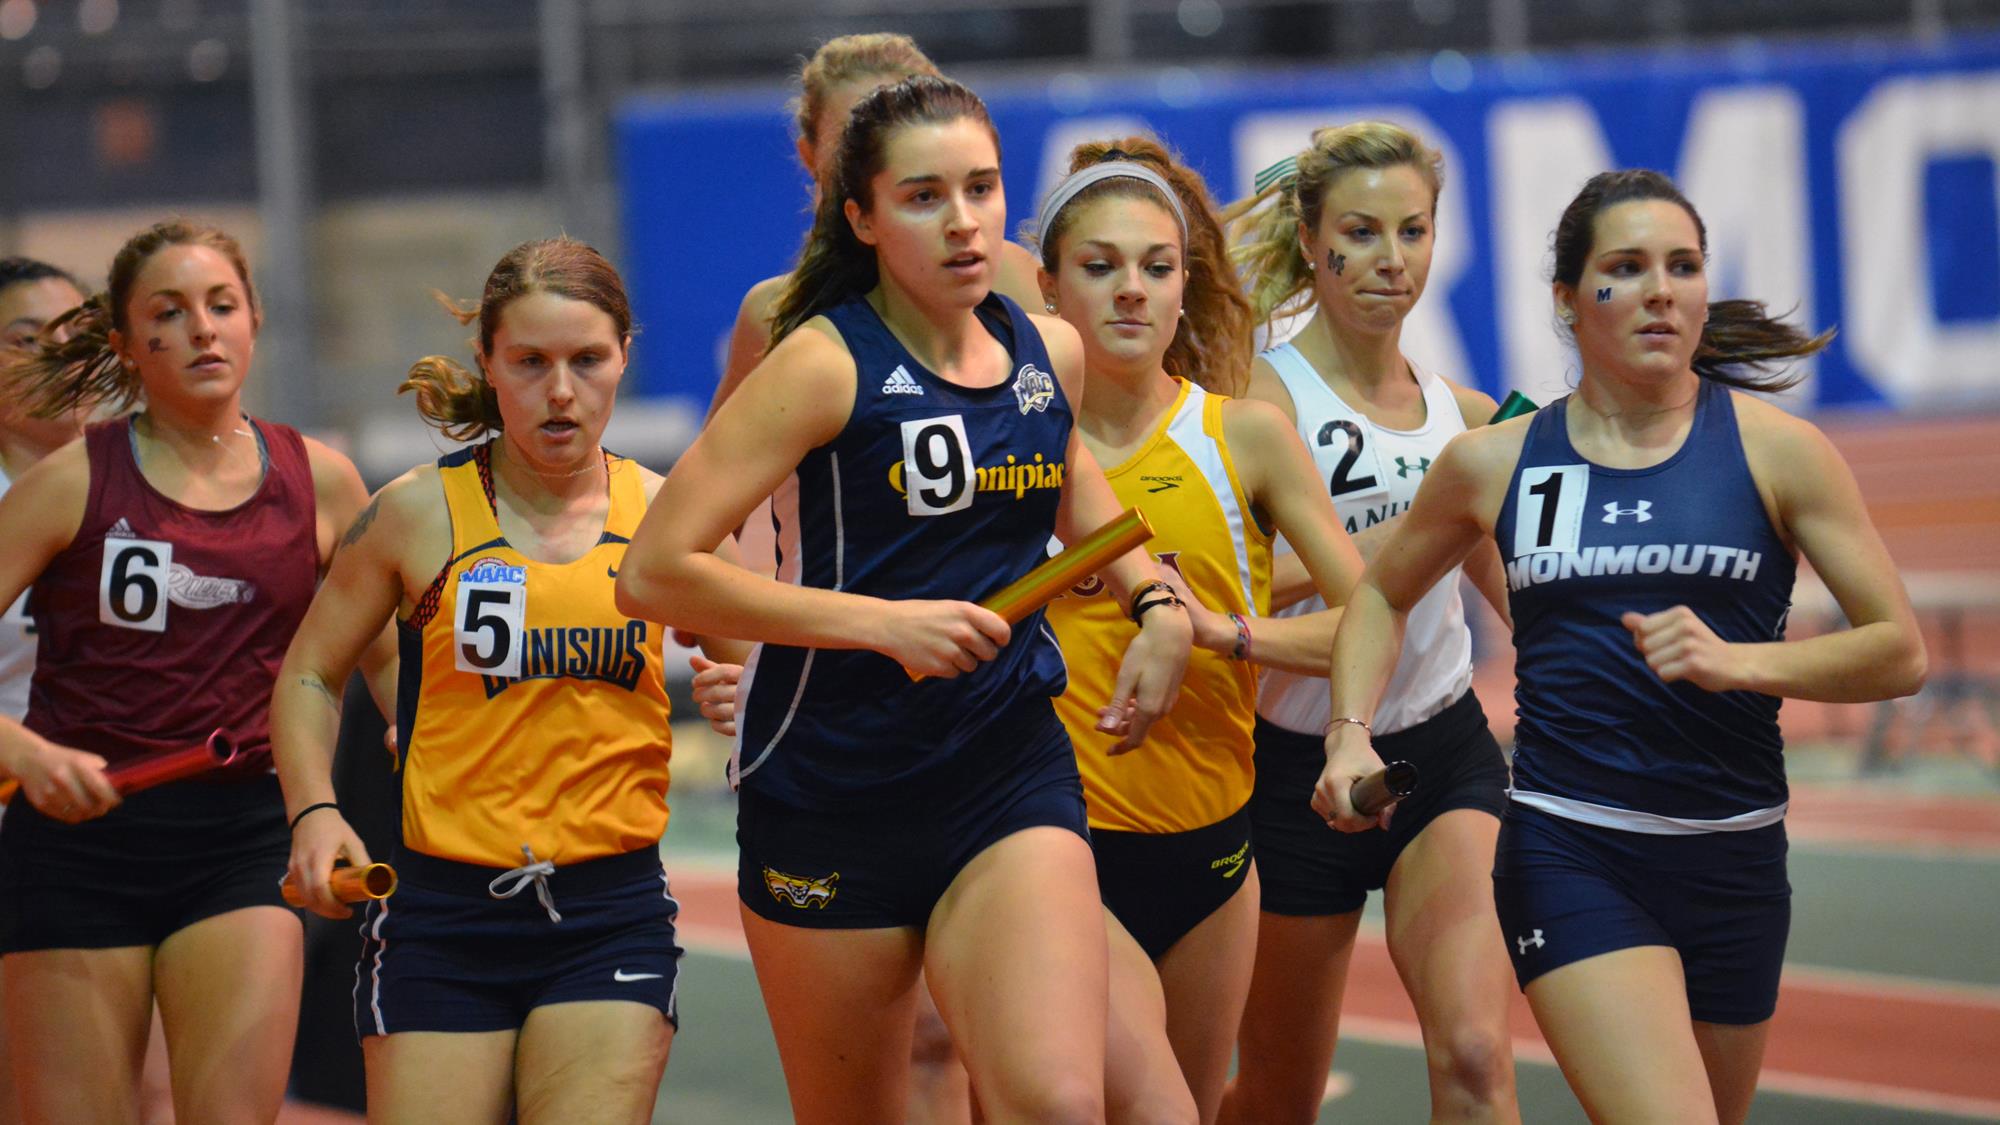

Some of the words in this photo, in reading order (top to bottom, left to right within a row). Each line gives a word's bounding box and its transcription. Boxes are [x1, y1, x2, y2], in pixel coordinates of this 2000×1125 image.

[1596, 287, 1612, 303] M
[882, 383, 924, 396] adidas
[914, 423, 966, 508] 9
[1317, 419, 1377, 496] 2
[1529, 472, 1564, 547] 1
[108, 546, 159, 622] 6
[460, 565, 526, 584] MAAC
[1507, 543, 1762, 593] MONMOUTH
[461, 589, 511, 669] 5
[481, 619, 647, 700] NISIUS
